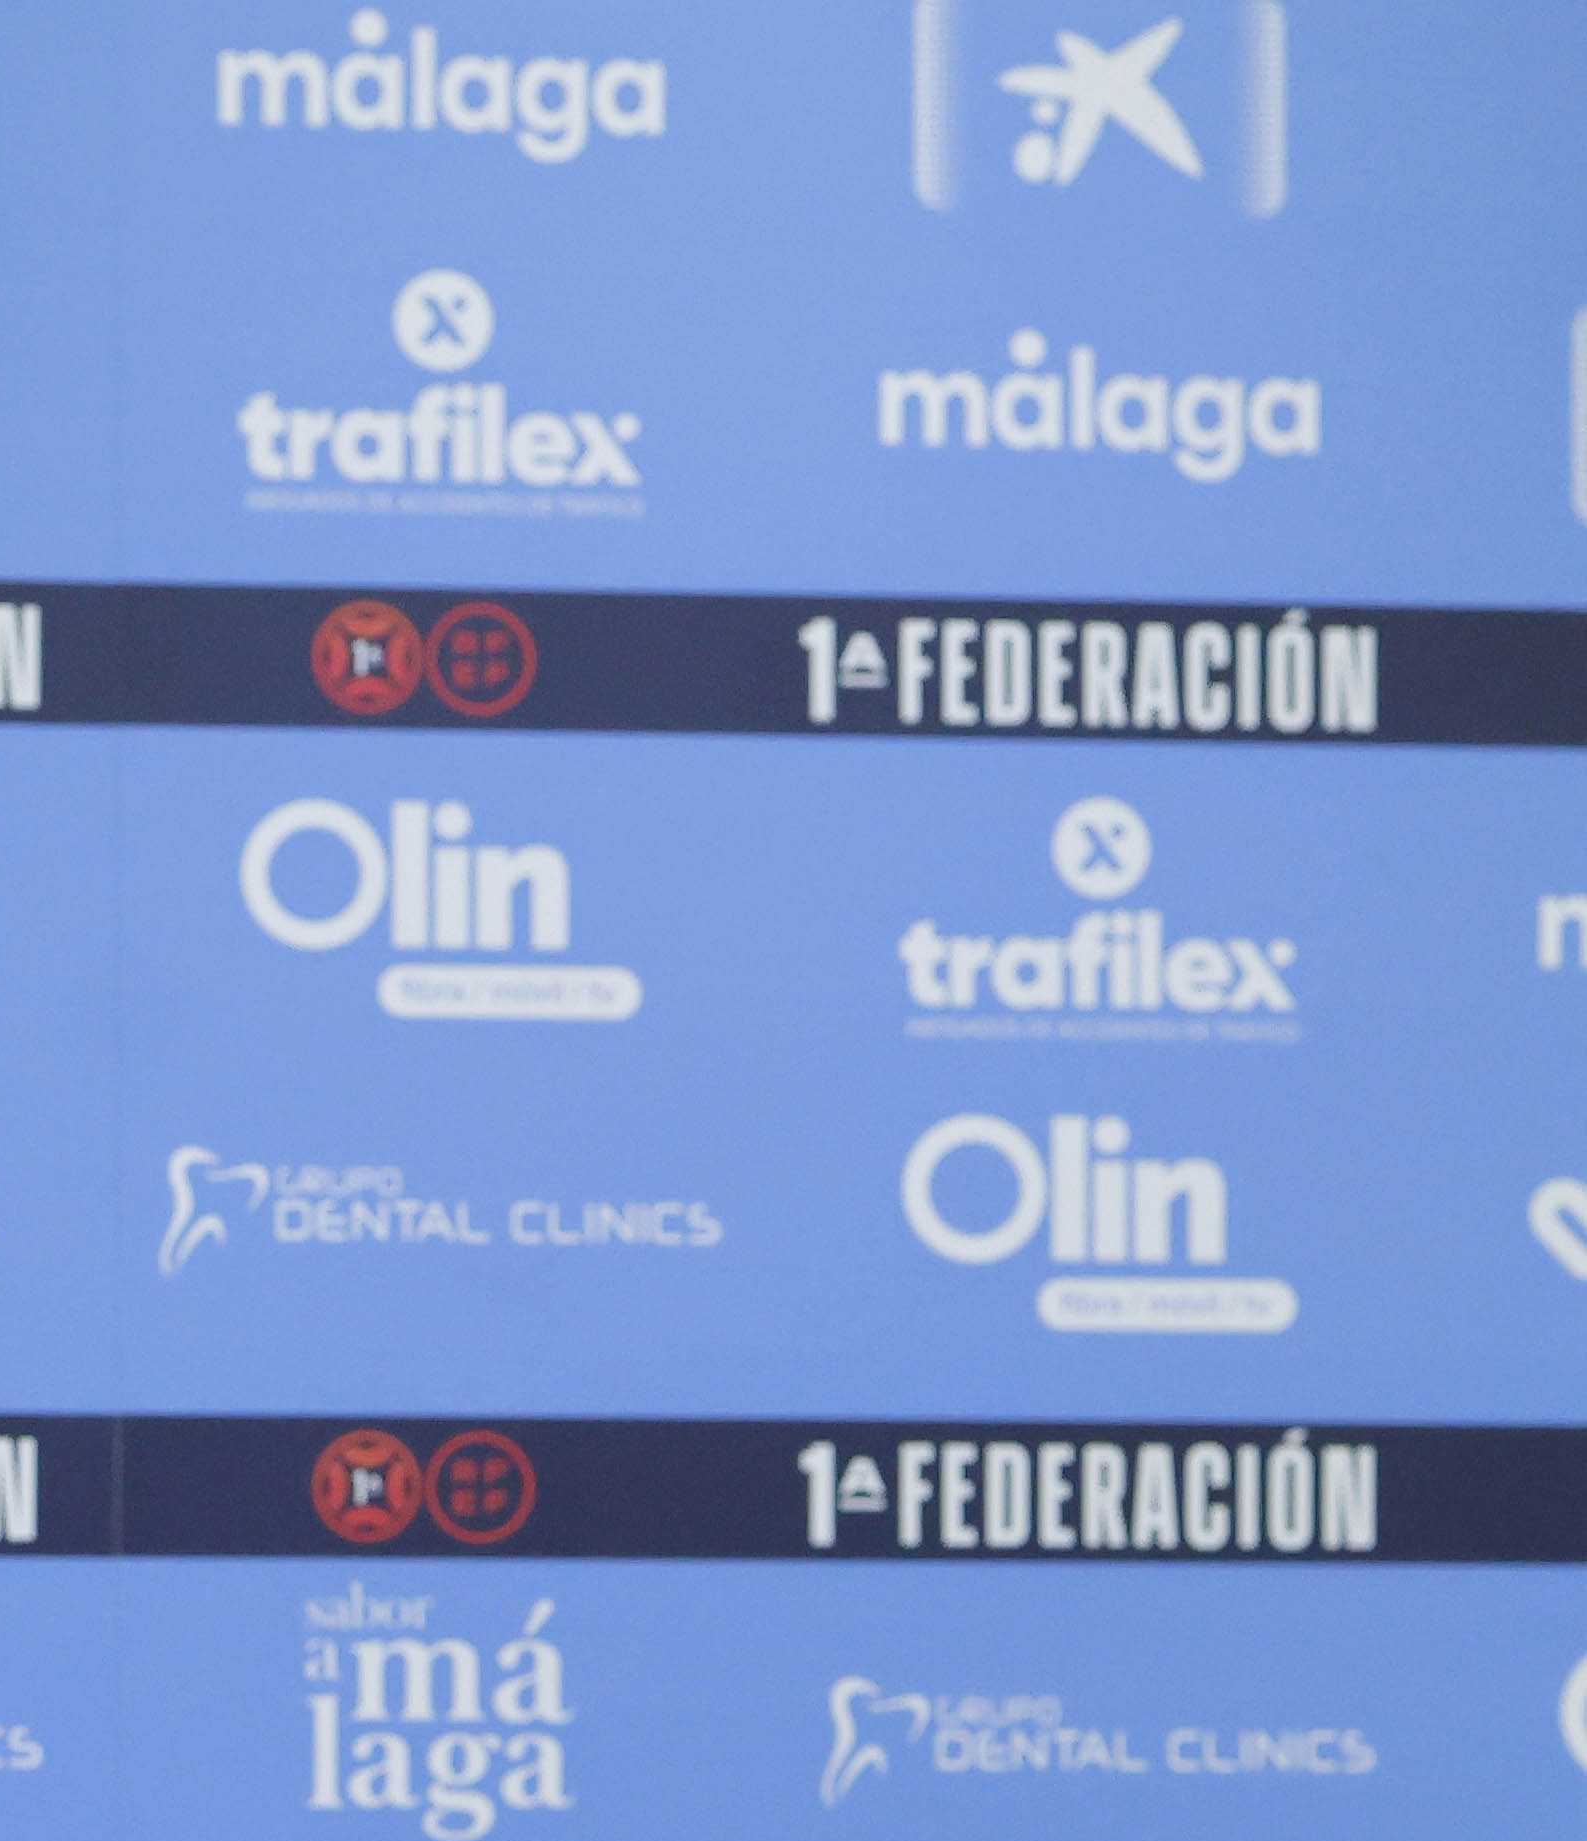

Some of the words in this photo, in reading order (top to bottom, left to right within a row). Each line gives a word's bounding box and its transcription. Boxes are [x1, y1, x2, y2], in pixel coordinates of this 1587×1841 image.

[238, 383, 640, 486] trafilex
[878, 329, 1320, 482] málaga
[899, 609, 1376, 732] FEDERACIÓN
[240, 799, 569, 951] Olin
[898, 910, 1295, 1012] trafilex
[901, 1114, 1226, 1264] Olin
[899, 1428, 1376, 1551] FEDERACIÓN
[304, 1639, 340, 1680] a
[352, 1599, 570, 1724] má
